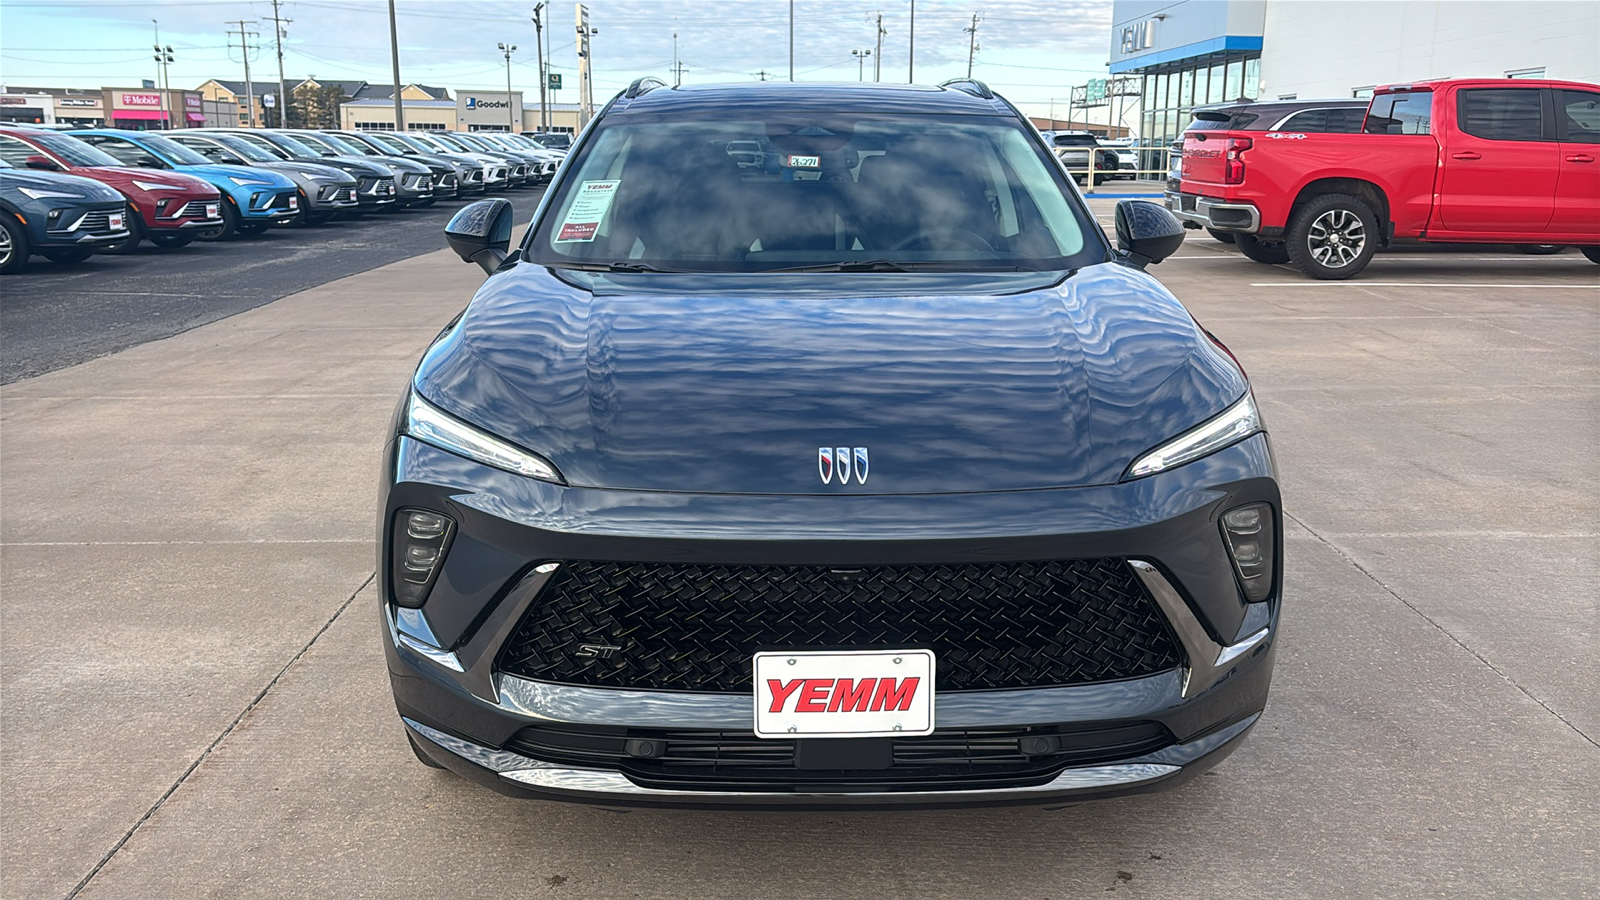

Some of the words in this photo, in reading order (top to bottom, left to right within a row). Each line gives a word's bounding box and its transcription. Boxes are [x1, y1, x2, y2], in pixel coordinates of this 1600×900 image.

[132, 96, 159, 105] Mobile
[476, 100, 512, 109] Goodwi
[575, 643, 622, 658] ST
[767, 677, 920, 713] YEMM
